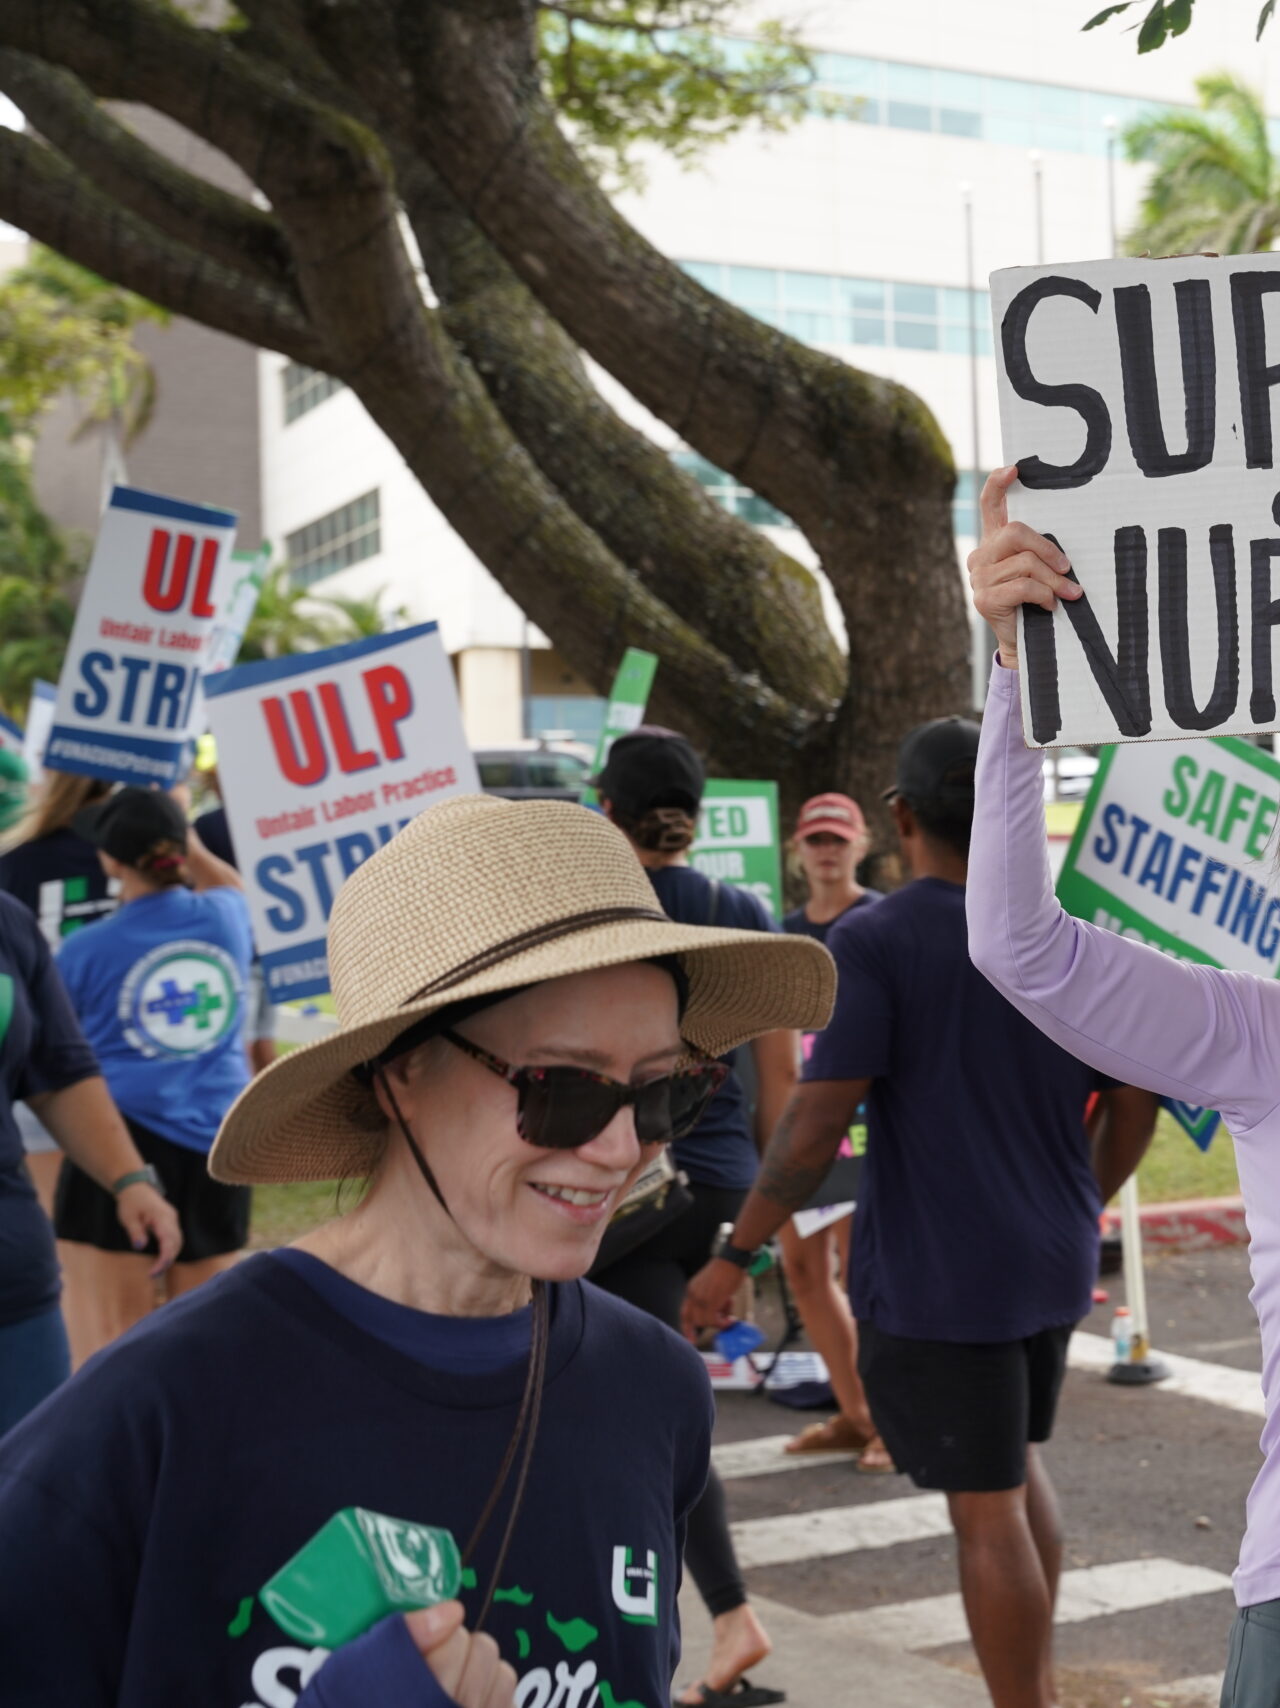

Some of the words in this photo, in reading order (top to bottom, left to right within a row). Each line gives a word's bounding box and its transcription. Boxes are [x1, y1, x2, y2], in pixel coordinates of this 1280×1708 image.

[157, 628, 206, 653] Labo
[260, 663, 415, 788] ULP
[255, 804, 317, 840] Unfair
[320, 787, 377, 823] Labor
[381, 765, 458, 807] Practice
[694, 805, 749, 839] ED
[1162, 754, 1279, 861] SAFE
